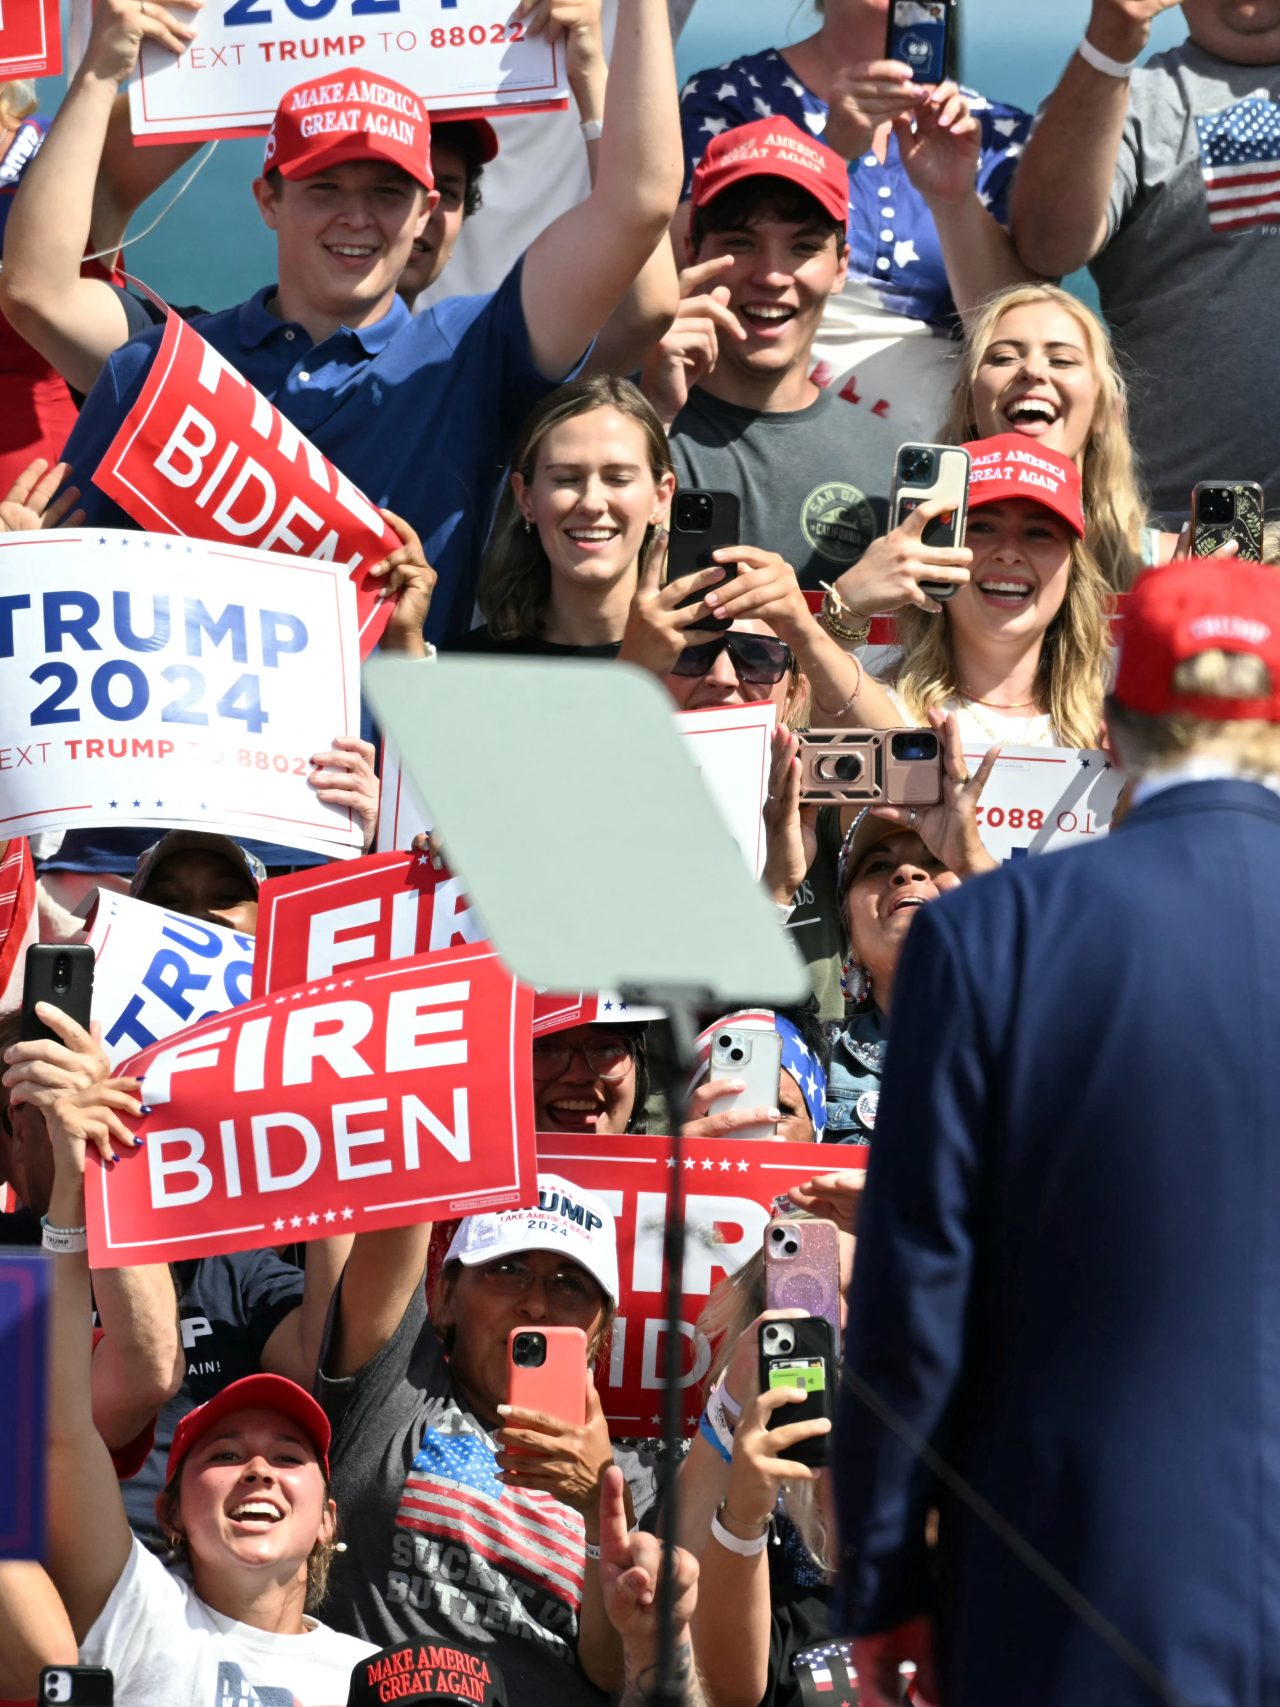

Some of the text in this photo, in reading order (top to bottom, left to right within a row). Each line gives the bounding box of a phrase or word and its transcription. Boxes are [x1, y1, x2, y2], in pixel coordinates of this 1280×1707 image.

[258, 34, 366, 62] TRUMP
[378, 29, 417, 52] TO
[430, 21, 526, 49] 88022
[291, 80, 423, 122] MAKE AMERICA
[301, 109, 415, 147] GREAT AGAIN
[764, 133, 826, 168] AMERICA
[775, 149, 822, 174] AGAIN
[972, 450, 1066, 483] AKE AMERICA
[1018, 469, 1059, 493] AGAIN
[810, 489, 836, 513] SAN
[0, 590, 309, 668] TRUMP
[29, 659, 269, 734] 2024
[0, 742, 52, 770] EXT
[64, 739, 174, 760] TRUMP
[237, 749, 307, 776] 8802
[141, 981, 470, 1105] FIRE
[146, 1088, 471, 1209] BIDEN
[496, 1190, 603, 1232] UMP
[527, 1219, 568, 1237] 2024
[46, 1234, 70, 1245] TRUMP
[392, 1532, 496, 1592] SUCK
[367, 1644, 493, 1687] MAKE AMERICA
[379, 1669, 486, 1704] GREAT AGAIN
